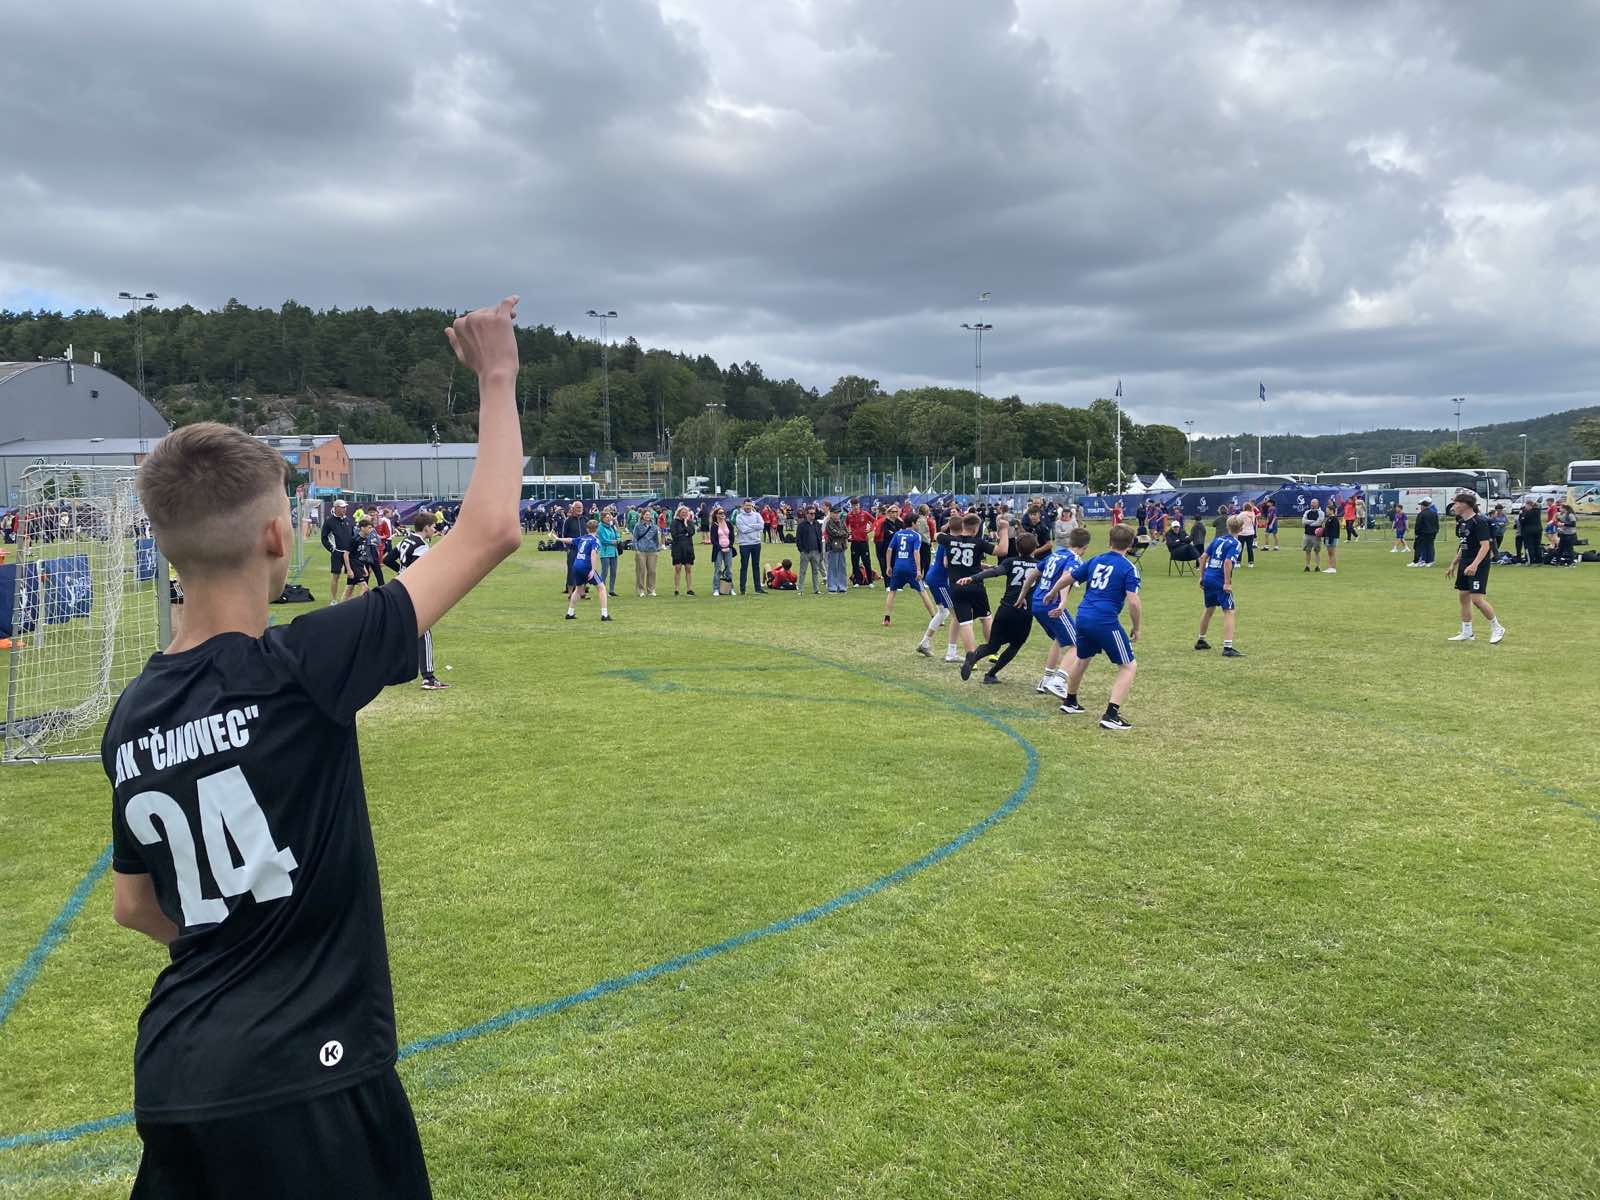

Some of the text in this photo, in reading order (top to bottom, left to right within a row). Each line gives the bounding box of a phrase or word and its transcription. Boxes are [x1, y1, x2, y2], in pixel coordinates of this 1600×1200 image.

[900, 536, 907, 551] 5
[1215, 541, 1225, 558] 4
[950, 547, 974, 567] 28
[1090, 563, 1114, 590] 53
[1472, 580, 1481, 590] 5
[125, 765, 298, 927] 24
